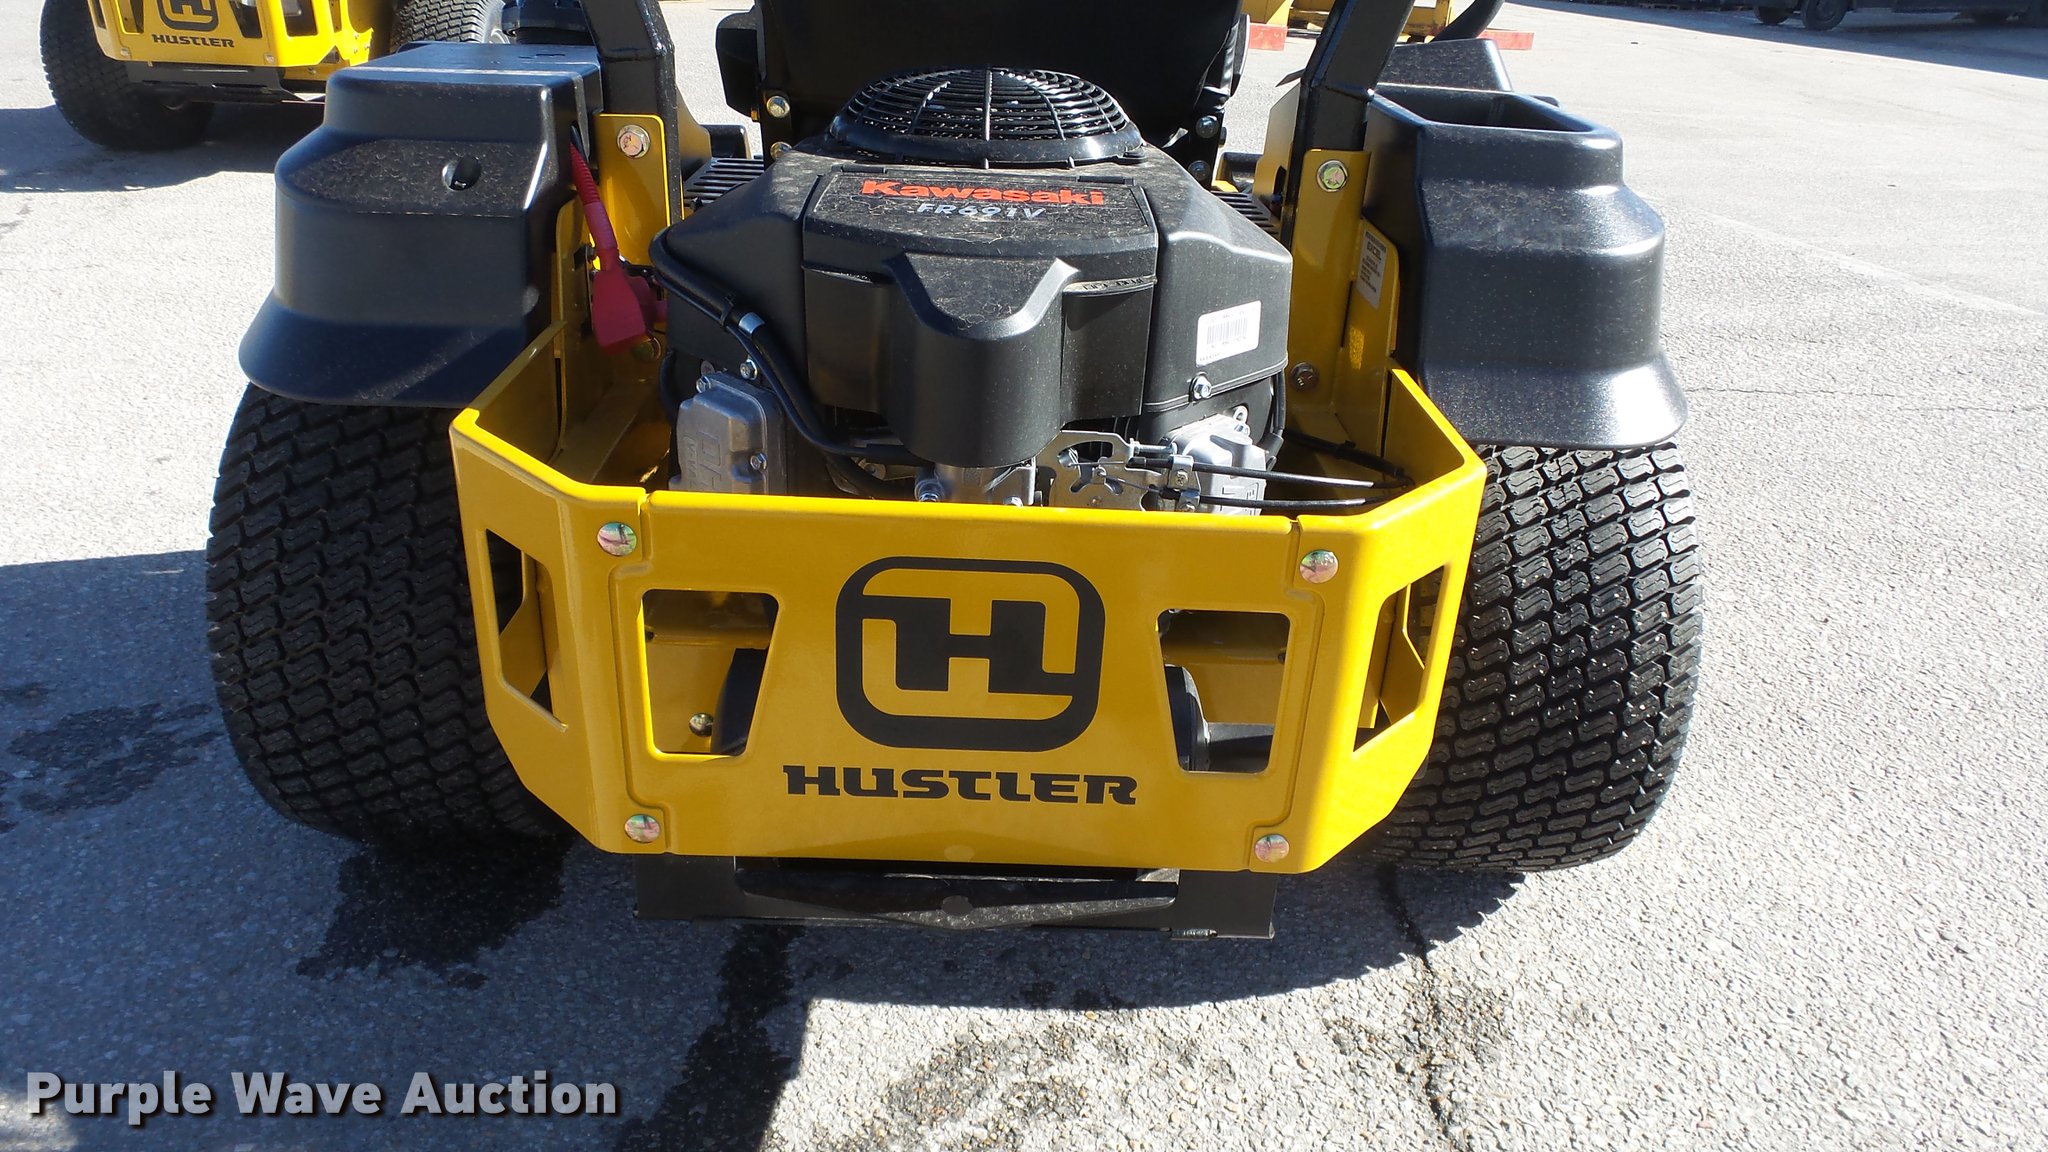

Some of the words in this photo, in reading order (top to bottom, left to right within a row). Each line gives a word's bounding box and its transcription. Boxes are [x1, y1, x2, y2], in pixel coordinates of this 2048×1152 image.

[152, 34, 235, 48] HUSTLER
[861, 180, 1105, 205] Kawasaki
[916, 203, 1046, 219] FR691V
[783, 765, 1138, 805] HUSTLER
